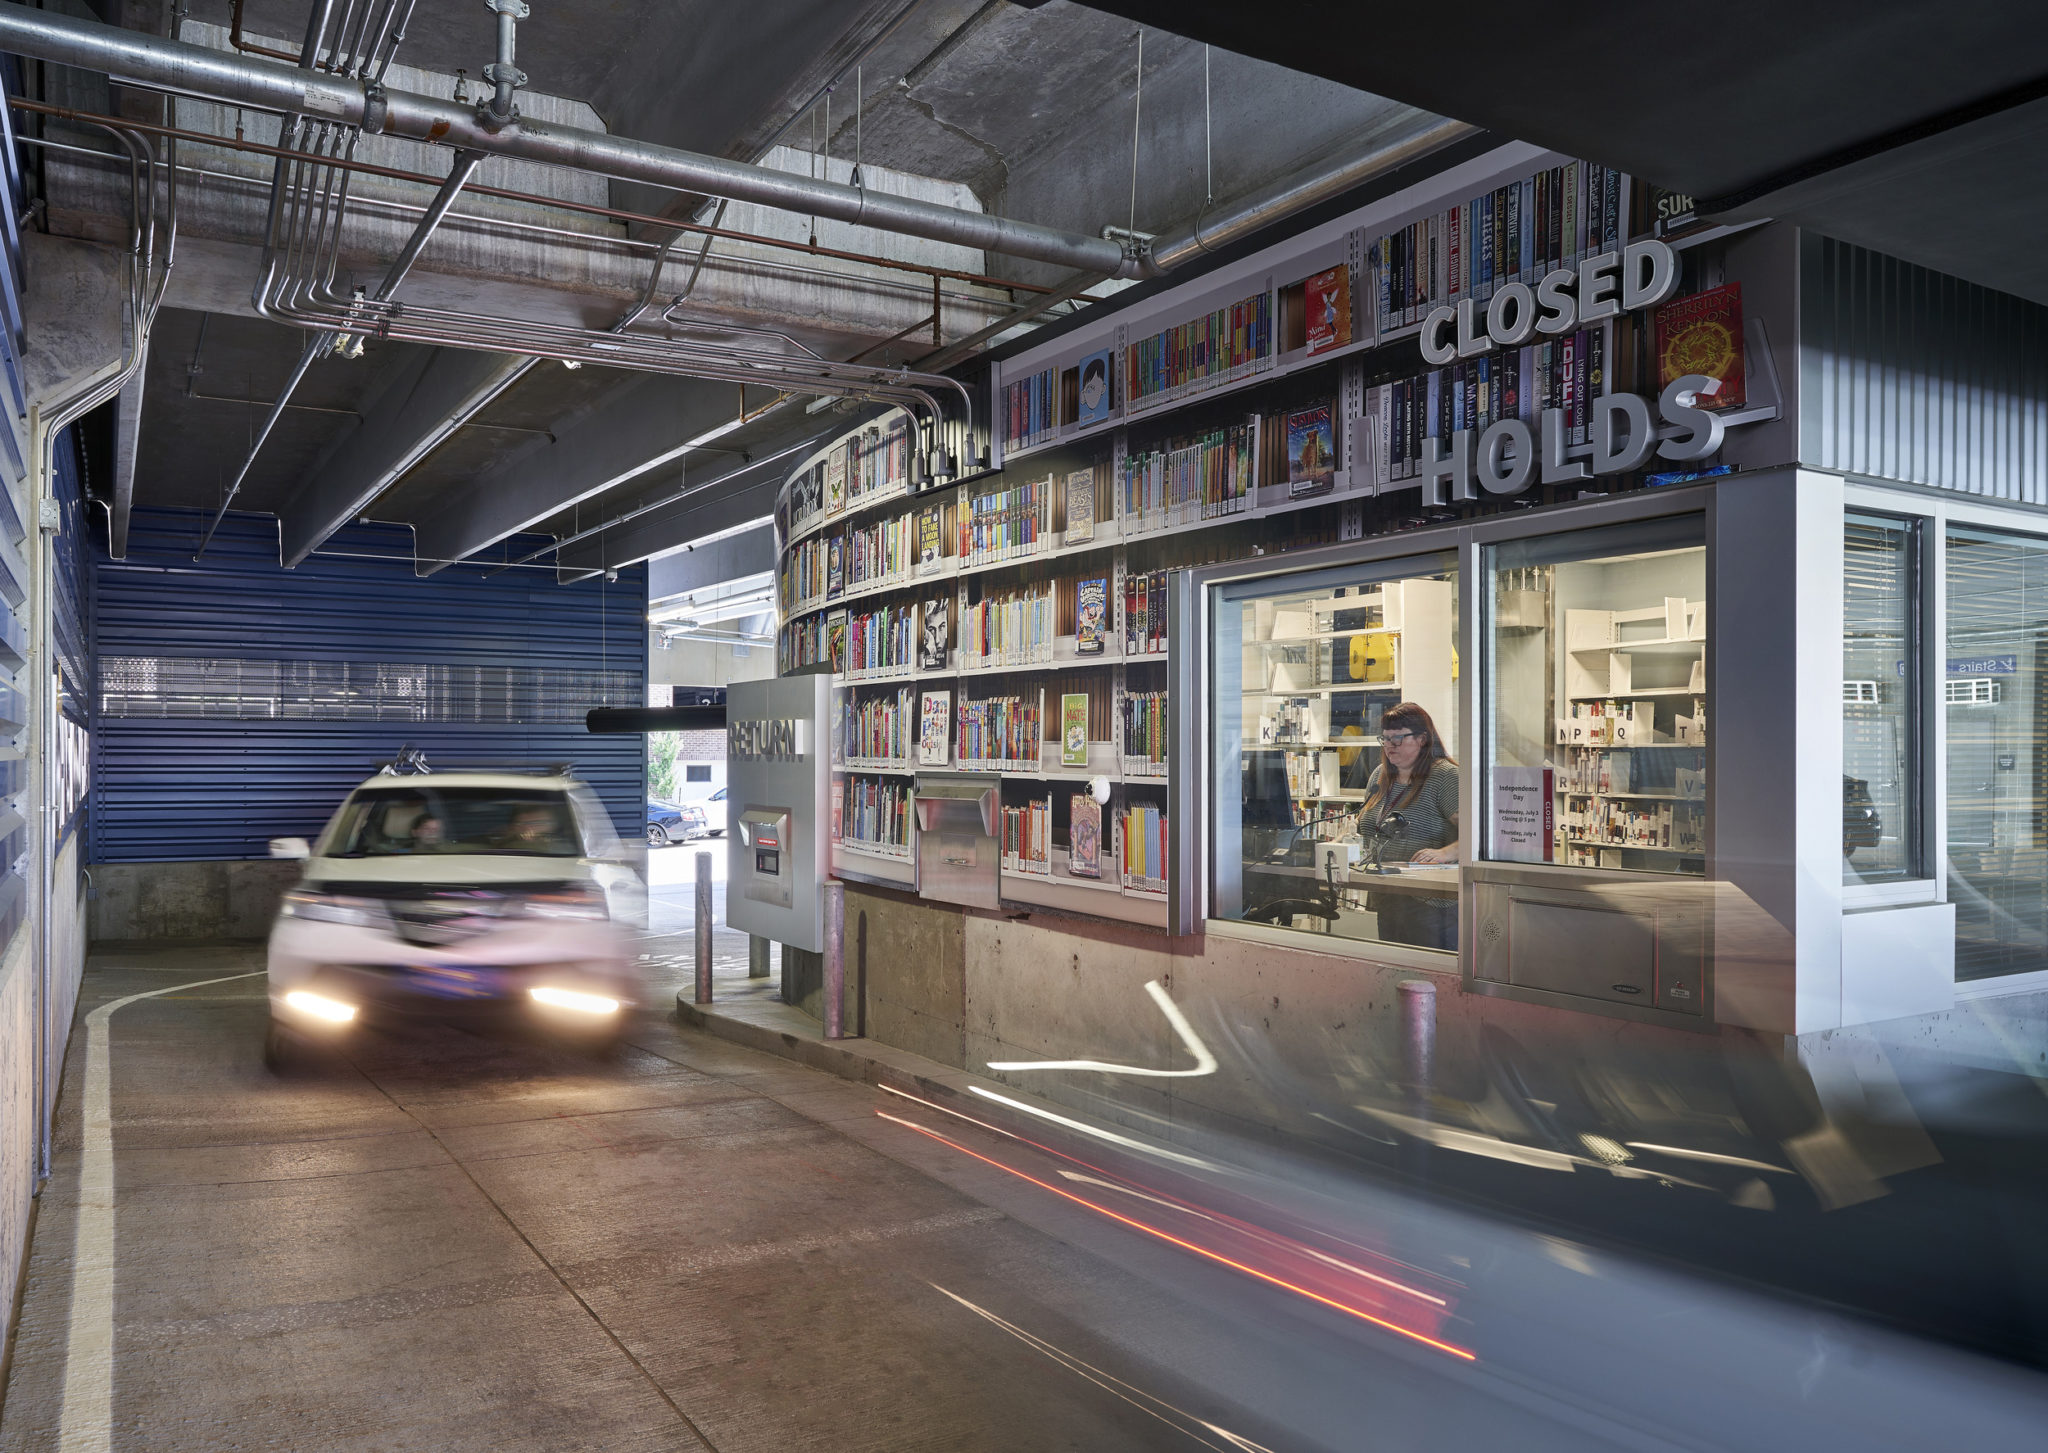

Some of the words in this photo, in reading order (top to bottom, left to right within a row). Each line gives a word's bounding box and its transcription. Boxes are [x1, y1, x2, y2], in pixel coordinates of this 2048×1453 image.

[1508, 203, 1518, 240] SURVIVE
[1450, 225, 1459, 252] CRAWL
[1482, 213, 1493, 262] PIECES
[1420, 239, 1680, 365] CLOSED
[1656, 289, 1738, 324] SHERRILYN
[1665, 307, 1731, 335] KENYON
[1577, 358, 1585, 383] LYING
[1466, 382, 1477, 431] WATERFA
[1422, 374, 1725, 507] HOLDS
[921, 515, 931, 525] HOW
[921, 525, 927, 534] TO
[928, 521, 938, 533] FAKE
[926, 529, 939, 542] MOON
[921, 538, 940, 551] LANDING
[1066, 709, 1086, 721] NATE
[728, 719, 804, 755] RETURN
[1262, 727, 1271, 740] K
[1574, 728, 1581, 740] P
[1617, 727, 1626, 740] Q
[1679, 726, 1687, 739] T
[1559, 776, 1567, 788] R
[1685, 780, 1693, 793] V
[1501, 815, 1518, 823] Closing
[1501, 829, 1522, 837] Thursday,
[1679, 832, 1690, 845] W
